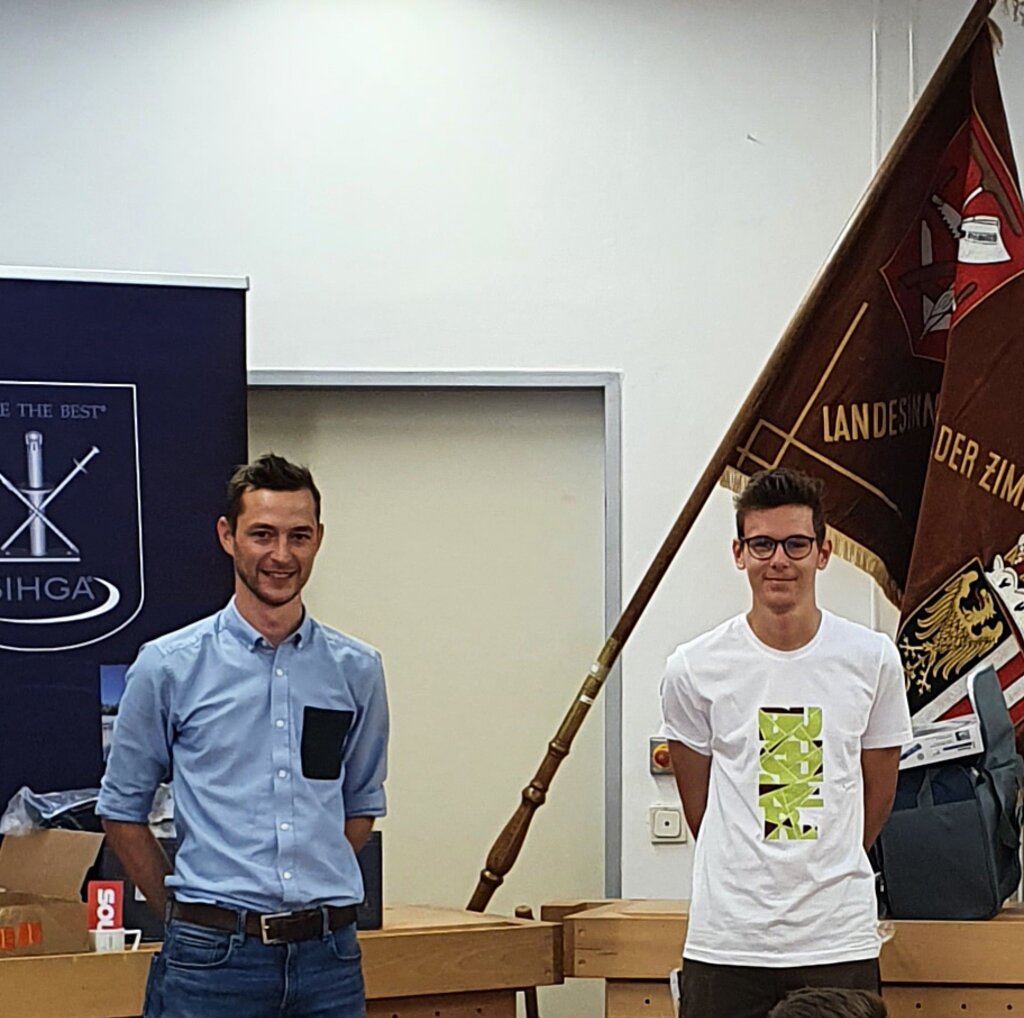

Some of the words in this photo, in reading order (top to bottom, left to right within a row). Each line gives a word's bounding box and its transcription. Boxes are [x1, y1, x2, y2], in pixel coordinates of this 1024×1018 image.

[17, 403, 53, 418] THE
[934, 425, 979, 479] DER
[0, 576, 95, 601] IHGA
